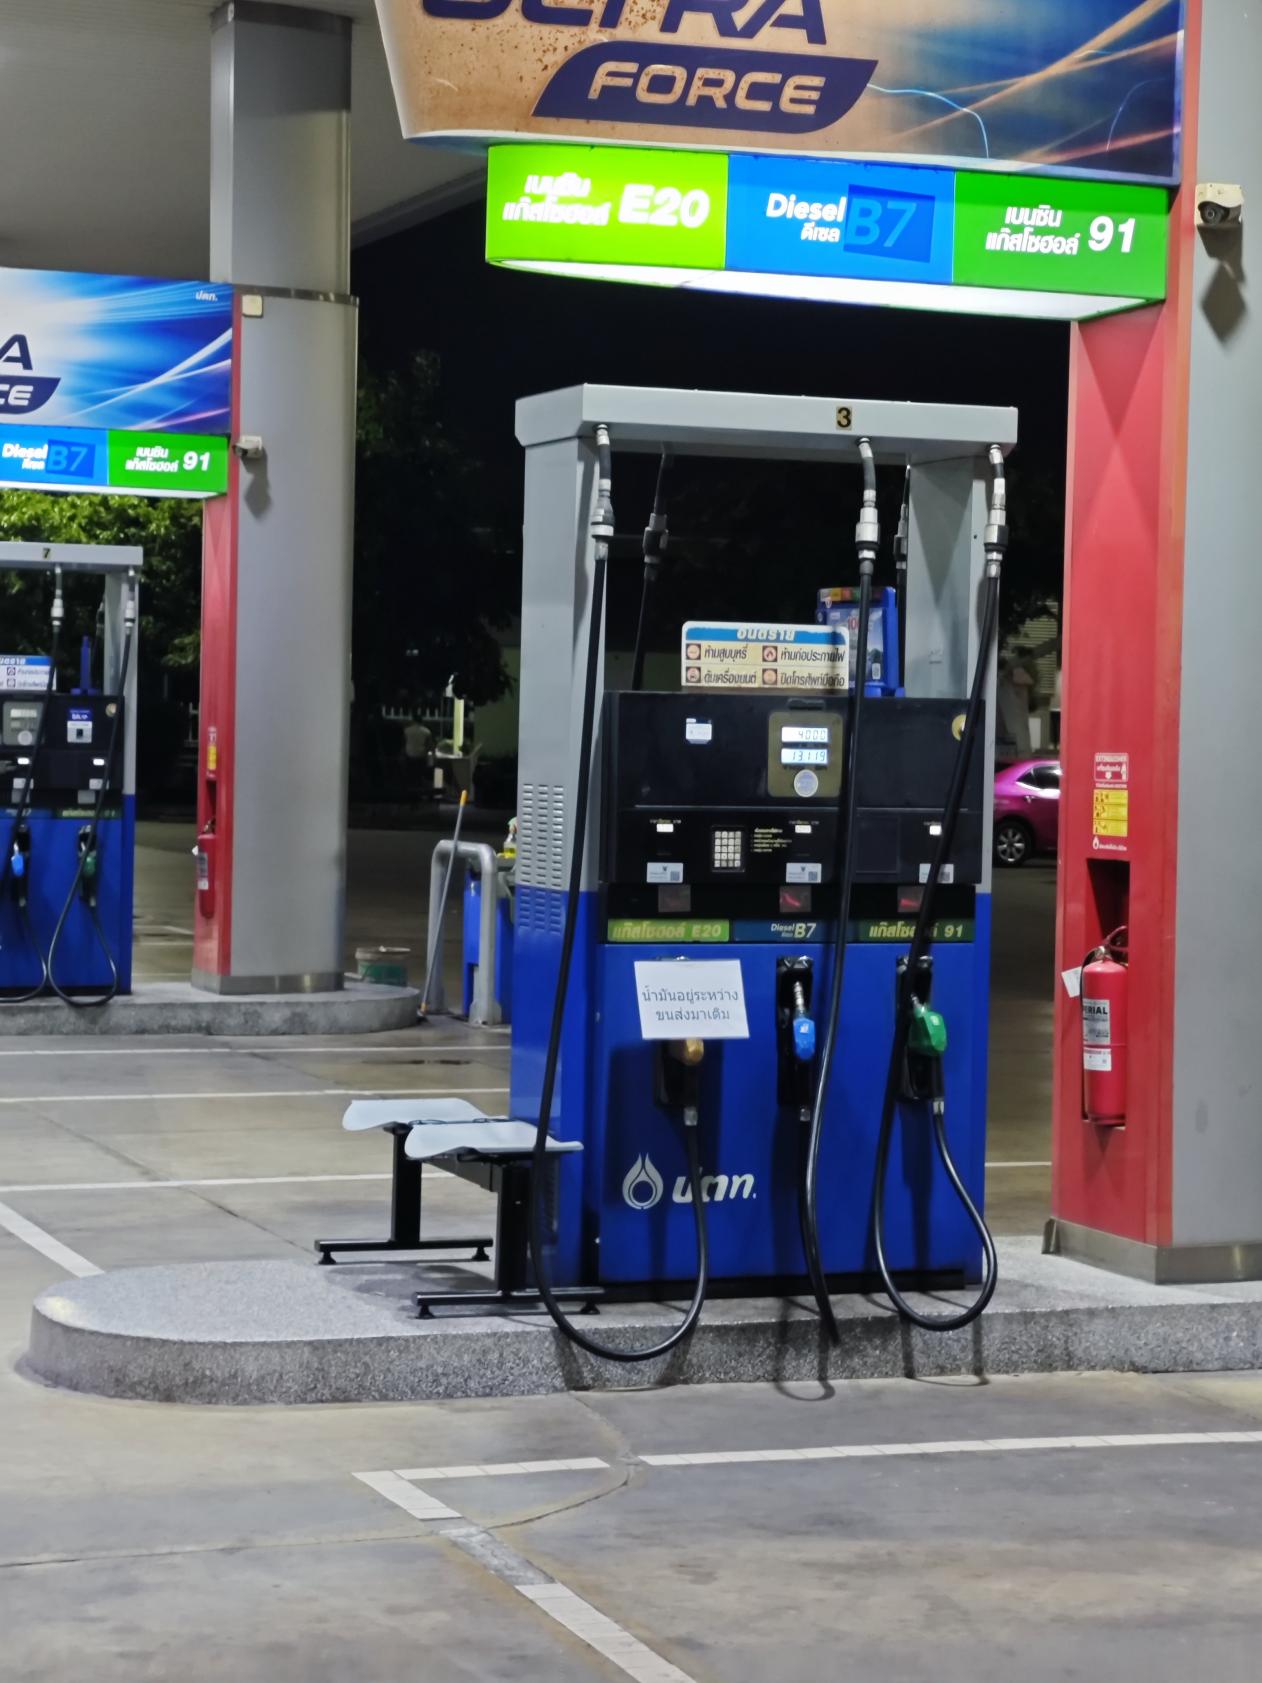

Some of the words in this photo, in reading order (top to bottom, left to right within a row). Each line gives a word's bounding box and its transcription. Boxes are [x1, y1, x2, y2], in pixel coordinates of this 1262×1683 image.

[587, 61, 826, 115] FORCE
[618, 183, 711, 229] E20
[1004, 204, 1063, 228] เบนซิน
[766, 193, 847, 223] Diesel
[849, 198, 917, 248] B7
[801, 222, 841, 242] ดีเซล
[1088, 215, 1136, 253] 91
[837, 406, 851, 428] 3
[48, 444, 89, 473] B7
[183, 451, 211, 471] 91
[43, 547, 51, 559] 7
[691, 923, 722, 938] E20
[794, 922, 816, 938] B7
[944, 924, 963, 938] 91
[642, 985, 739, 1004] น้ำมันอยู่ระหว่าง
[656, 1007, 730, 1021] ขนส่งมาเติม
